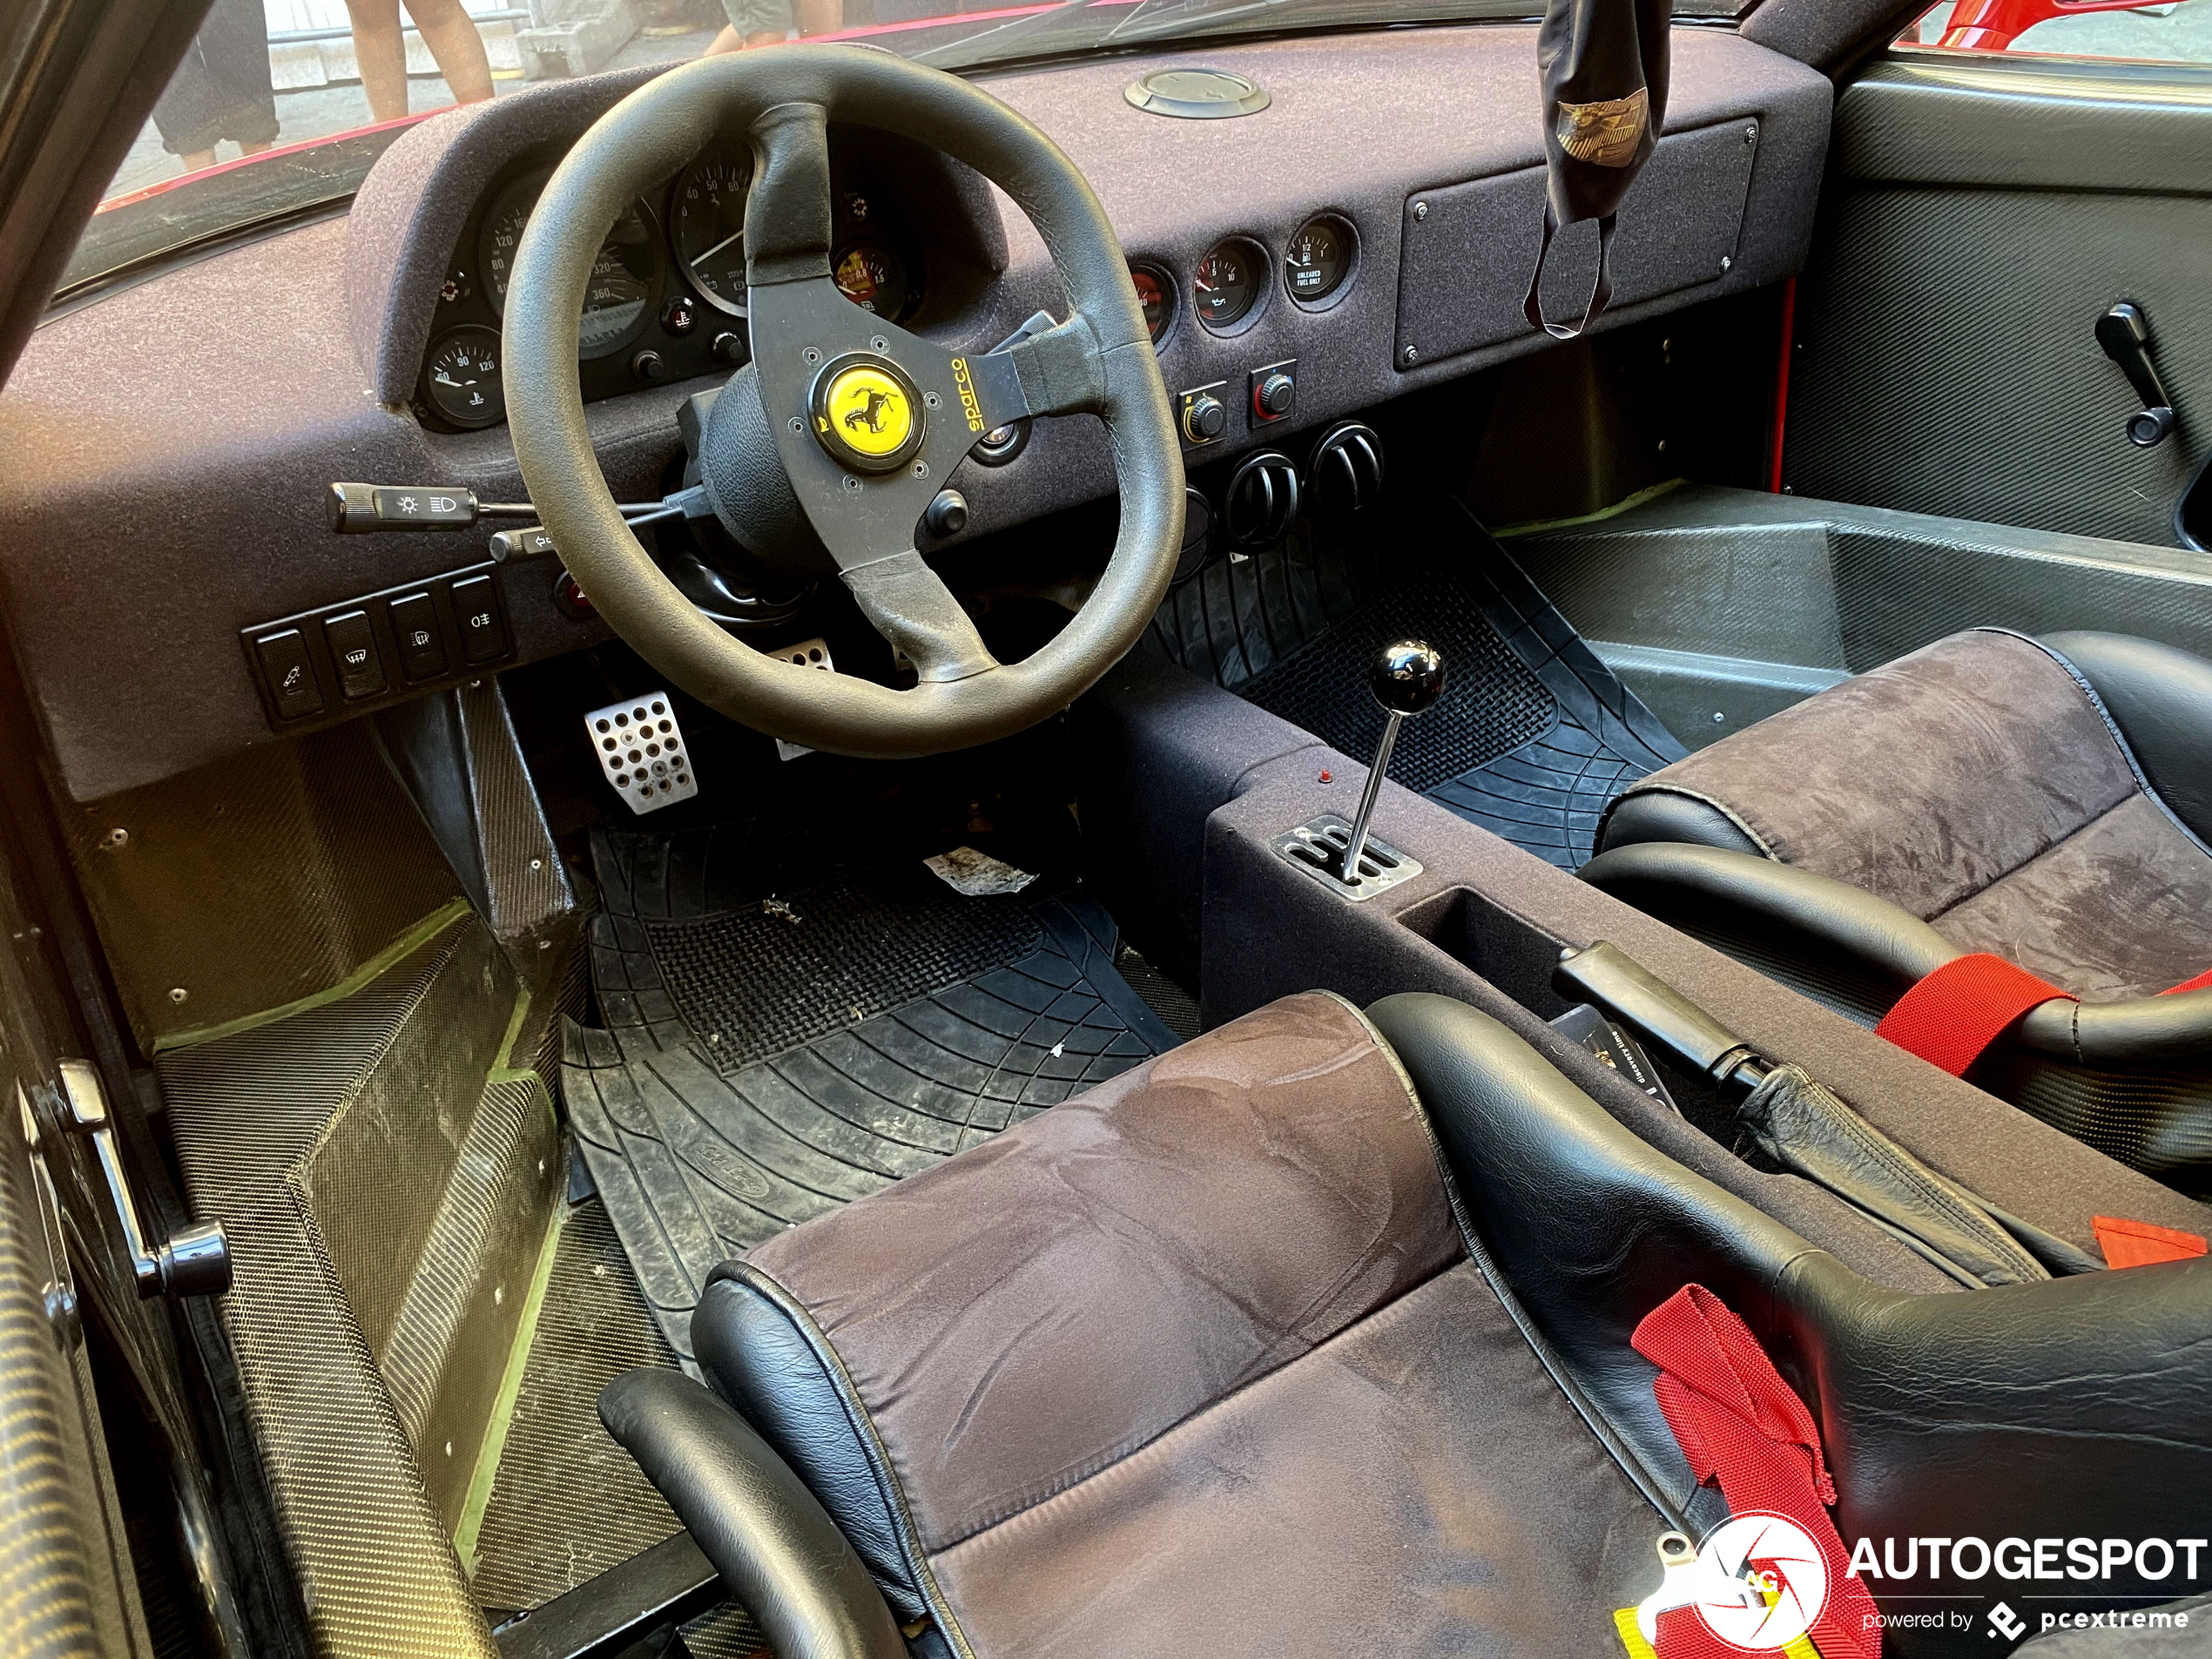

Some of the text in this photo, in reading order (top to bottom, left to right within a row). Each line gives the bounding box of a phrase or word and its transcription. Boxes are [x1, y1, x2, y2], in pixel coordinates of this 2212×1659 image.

[706, 179, 718, 191] 50
[728, 180, 739, 192] 60
[686, 188, 699, 199] 40
[496, 235, 514, 247] 120
[491, 260, 505, 270] 80
[594, 262, 610, 274] 320
[856, 268, 867, 279] 0.8
[1211, 267, 1217, 277] 5
[1228, 273, 1236, 282] 10
[1297, 270, 1321, 280] UNLEADED
[875, 274, 885, 284] 1.5
[592, 287, 610, 300] 360
[457, 355, 469, 367] 90
[479, 360, 496, 372] 120
[951, 357, 984, 432] sparco
[1612, 1031, 1645, 1083] discovery time
